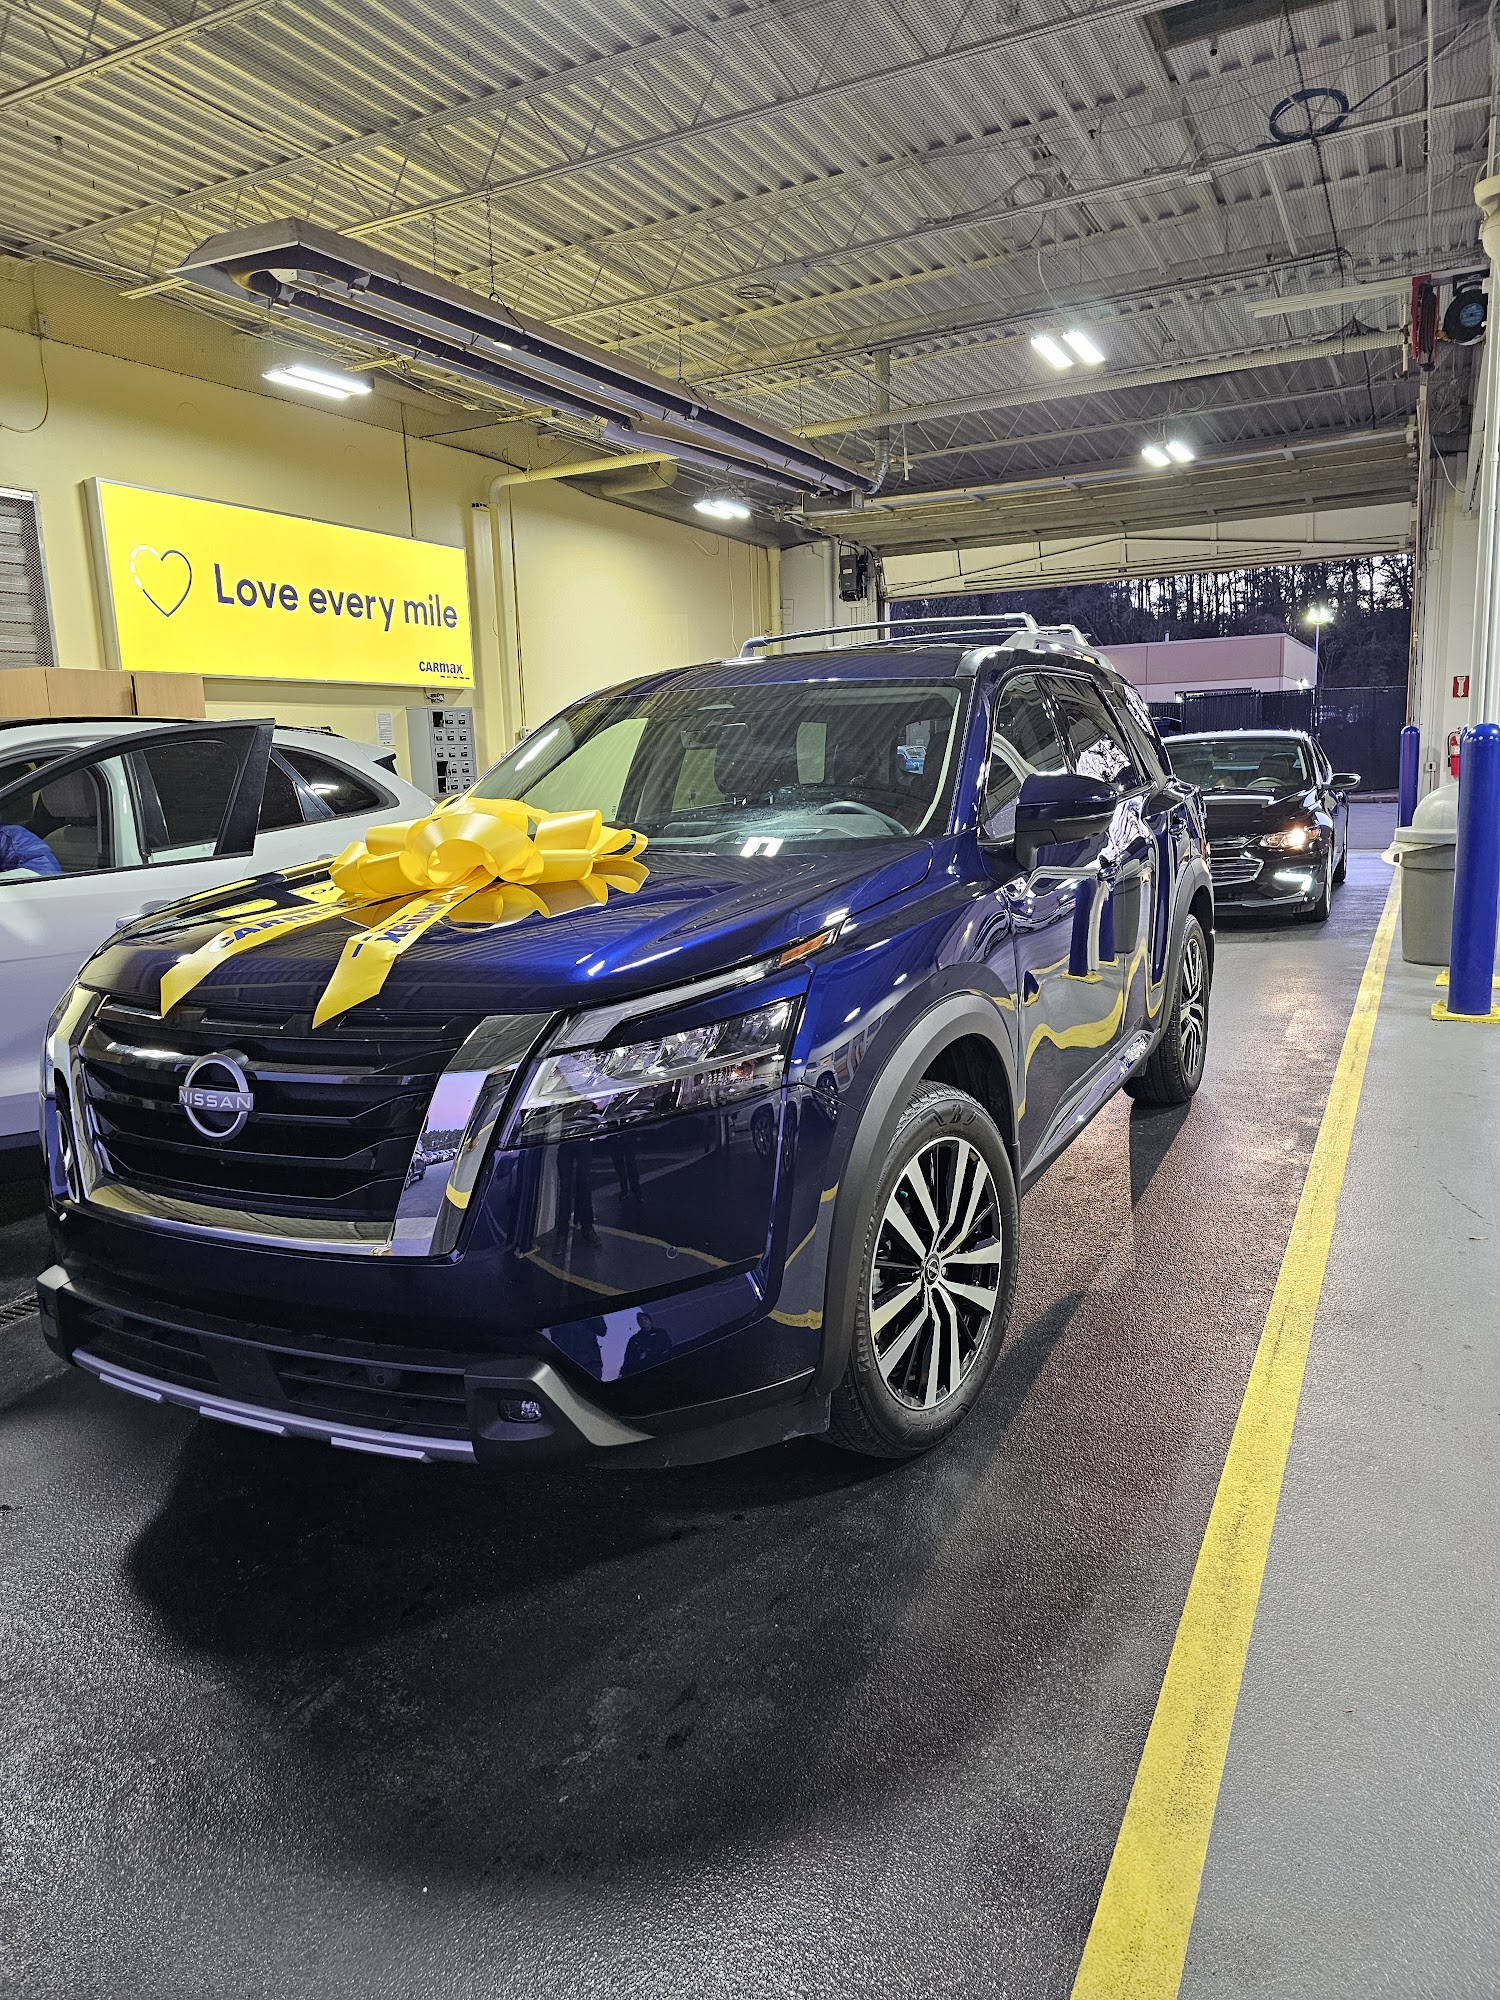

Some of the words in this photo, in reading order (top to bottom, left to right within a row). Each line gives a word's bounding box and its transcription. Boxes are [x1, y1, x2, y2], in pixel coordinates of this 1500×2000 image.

[214, 563, 299, 611] Love
[308, 588, 395, 632] every
[403, 594, 458, 628] mile
[418, 660, 464, 675] CARmax
[179, 1089, 251, 1109] NISSAN
